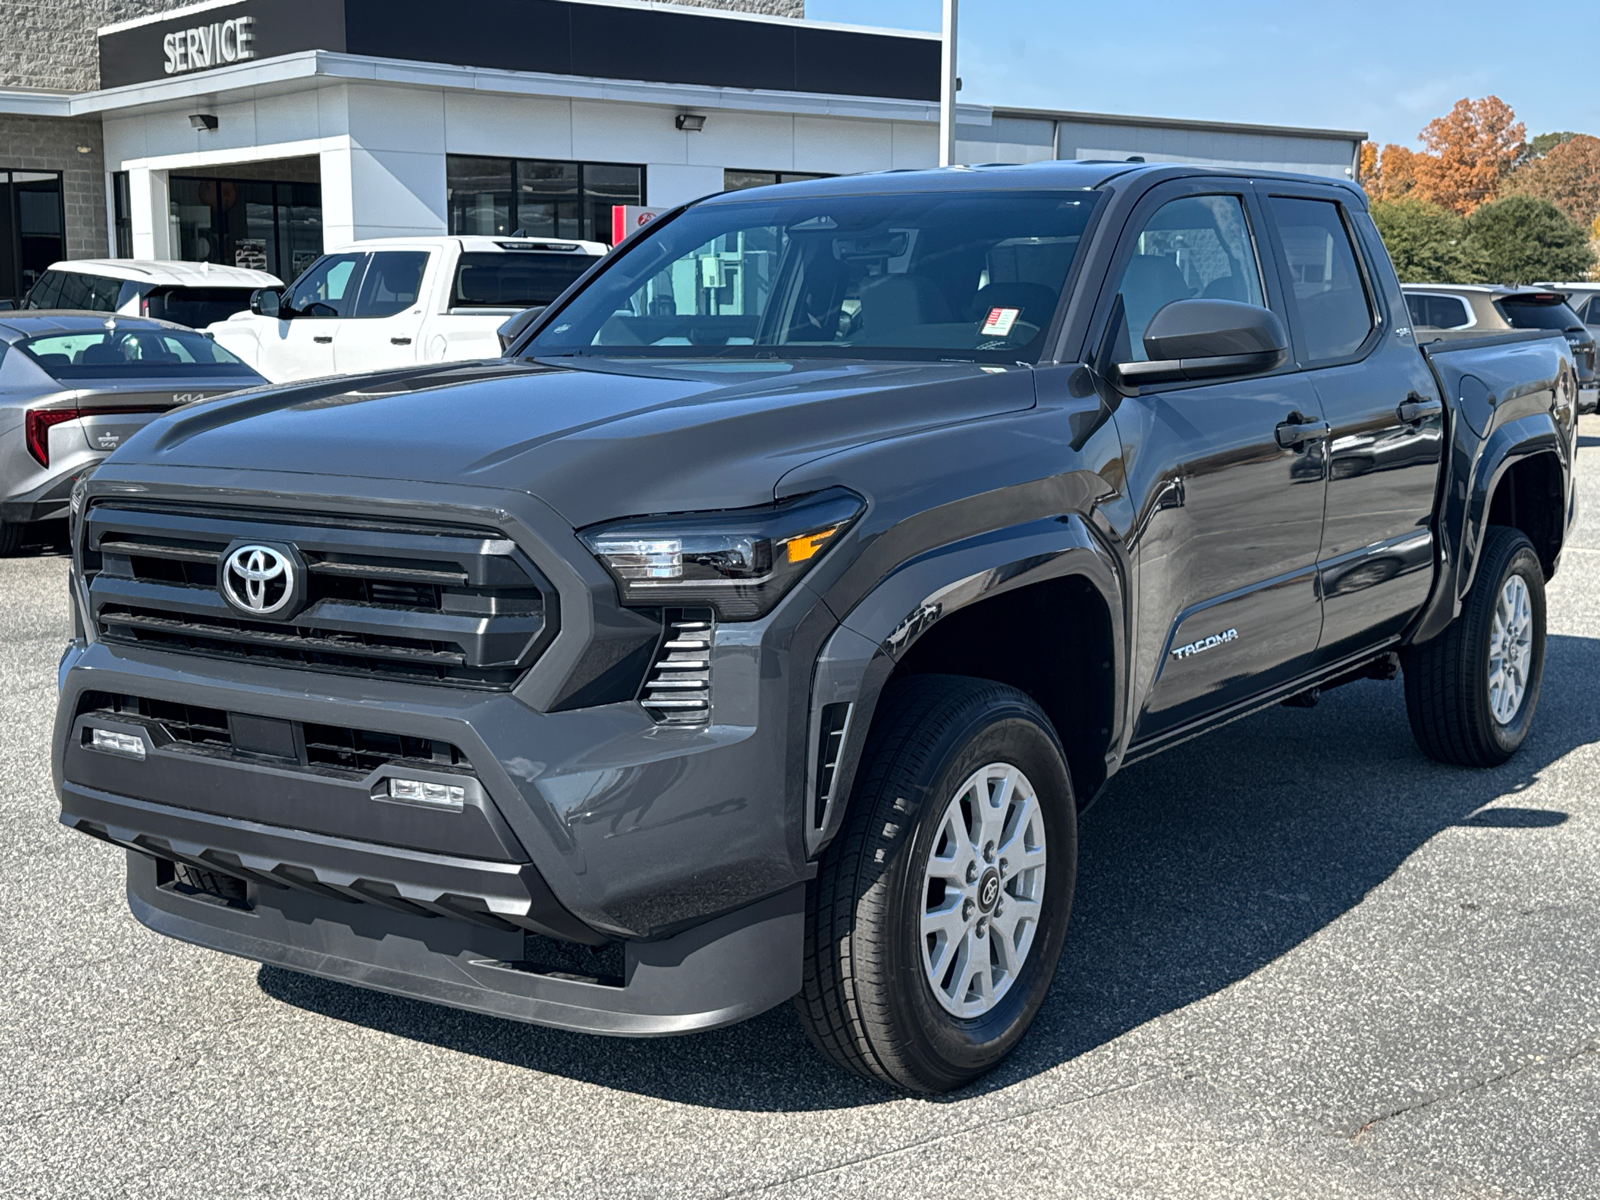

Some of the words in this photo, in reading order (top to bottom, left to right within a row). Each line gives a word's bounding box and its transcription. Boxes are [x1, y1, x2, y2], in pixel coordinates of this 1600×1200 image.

[163, 16, 256, 74] SERVICE
[172, 393, 205, 402] KIA
[1171, 628, 1239, 660] TACOMA
